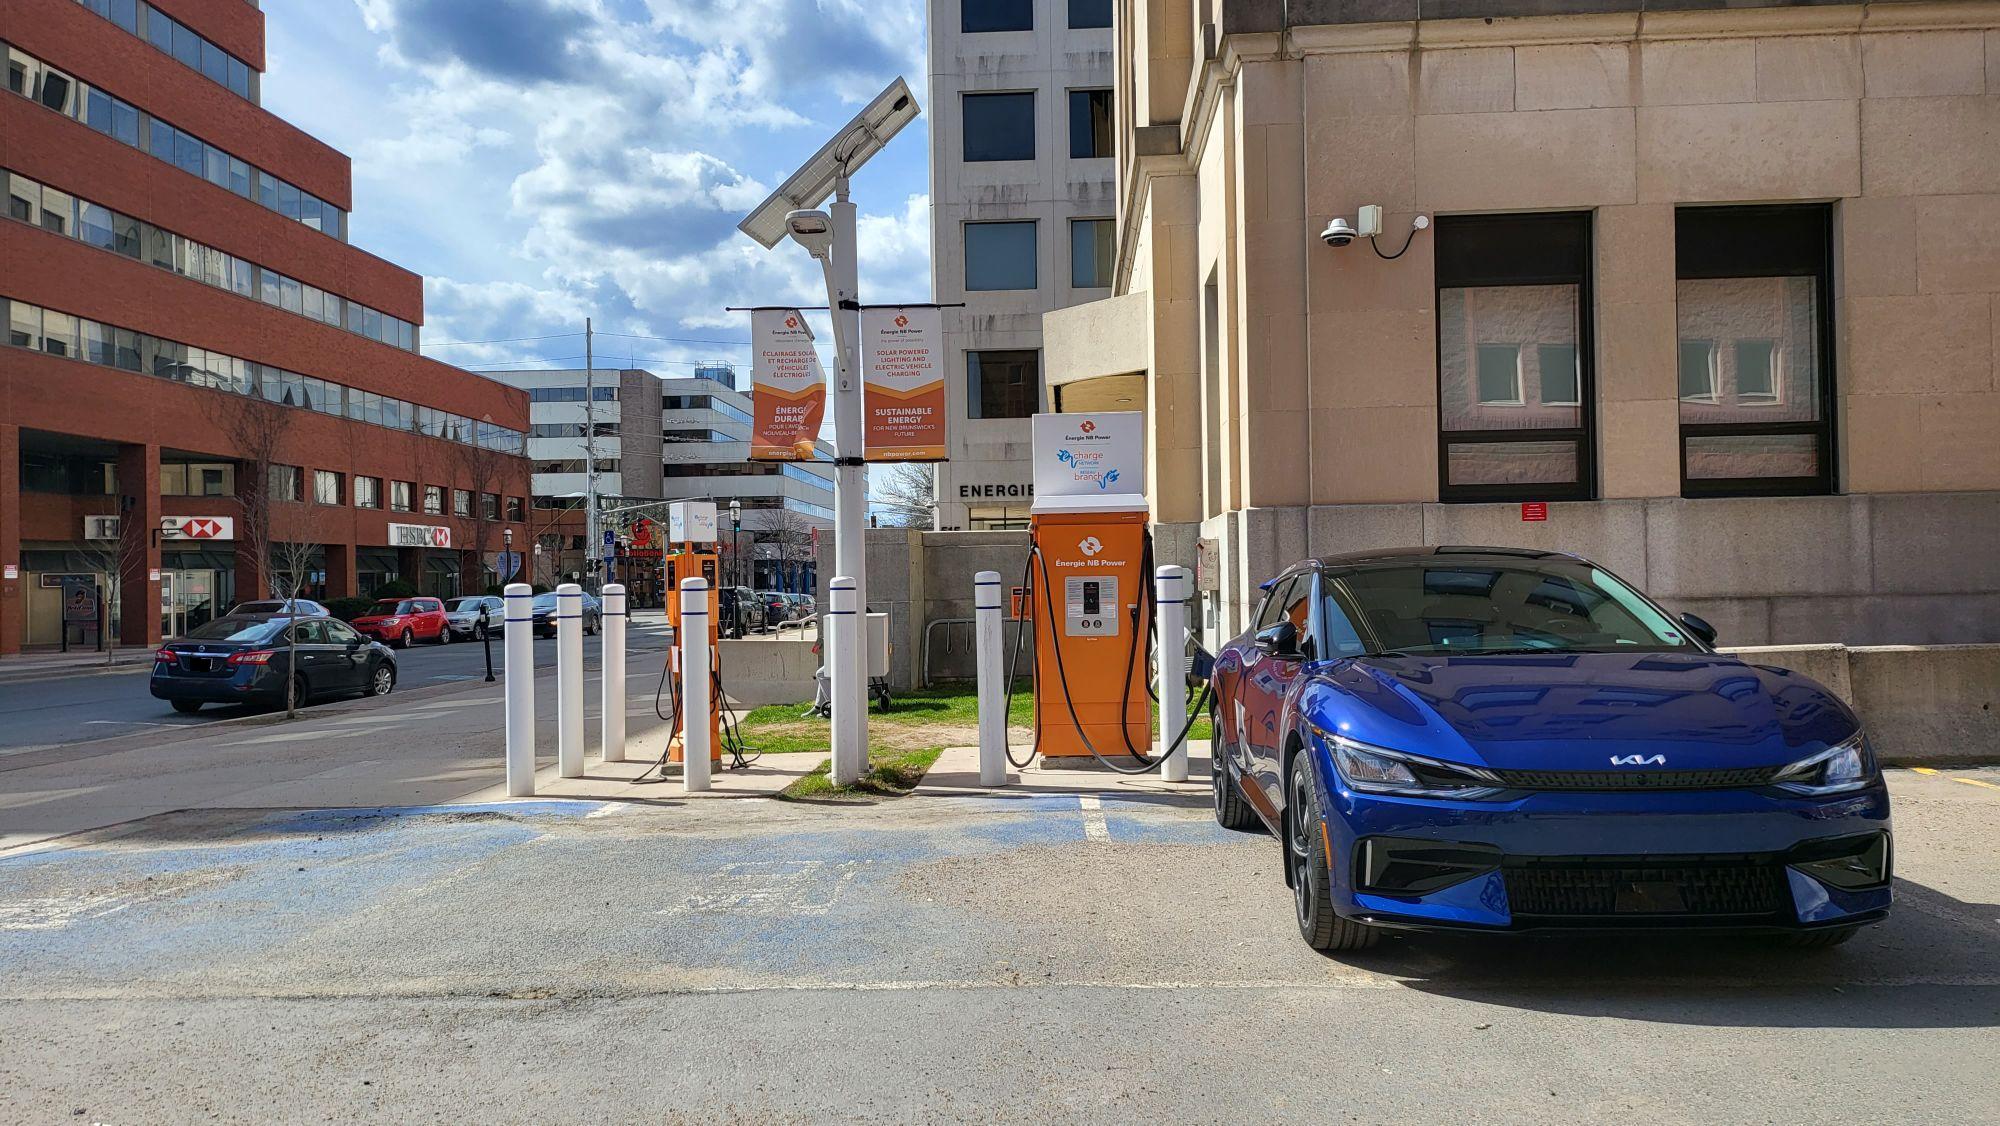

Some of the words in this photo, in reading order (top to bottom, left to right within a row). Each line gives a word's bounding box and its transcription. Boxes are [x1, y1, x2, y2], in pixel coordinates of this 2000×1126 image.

[875, 407, 932, 416] SUSTAINABLE
[888, 416, 922, 424] ENERGY
[1074, 471, 1103, 481] branch
[396, 525, 432, 545] HSBC
[1055, 558, 1085, 567] Énergie
